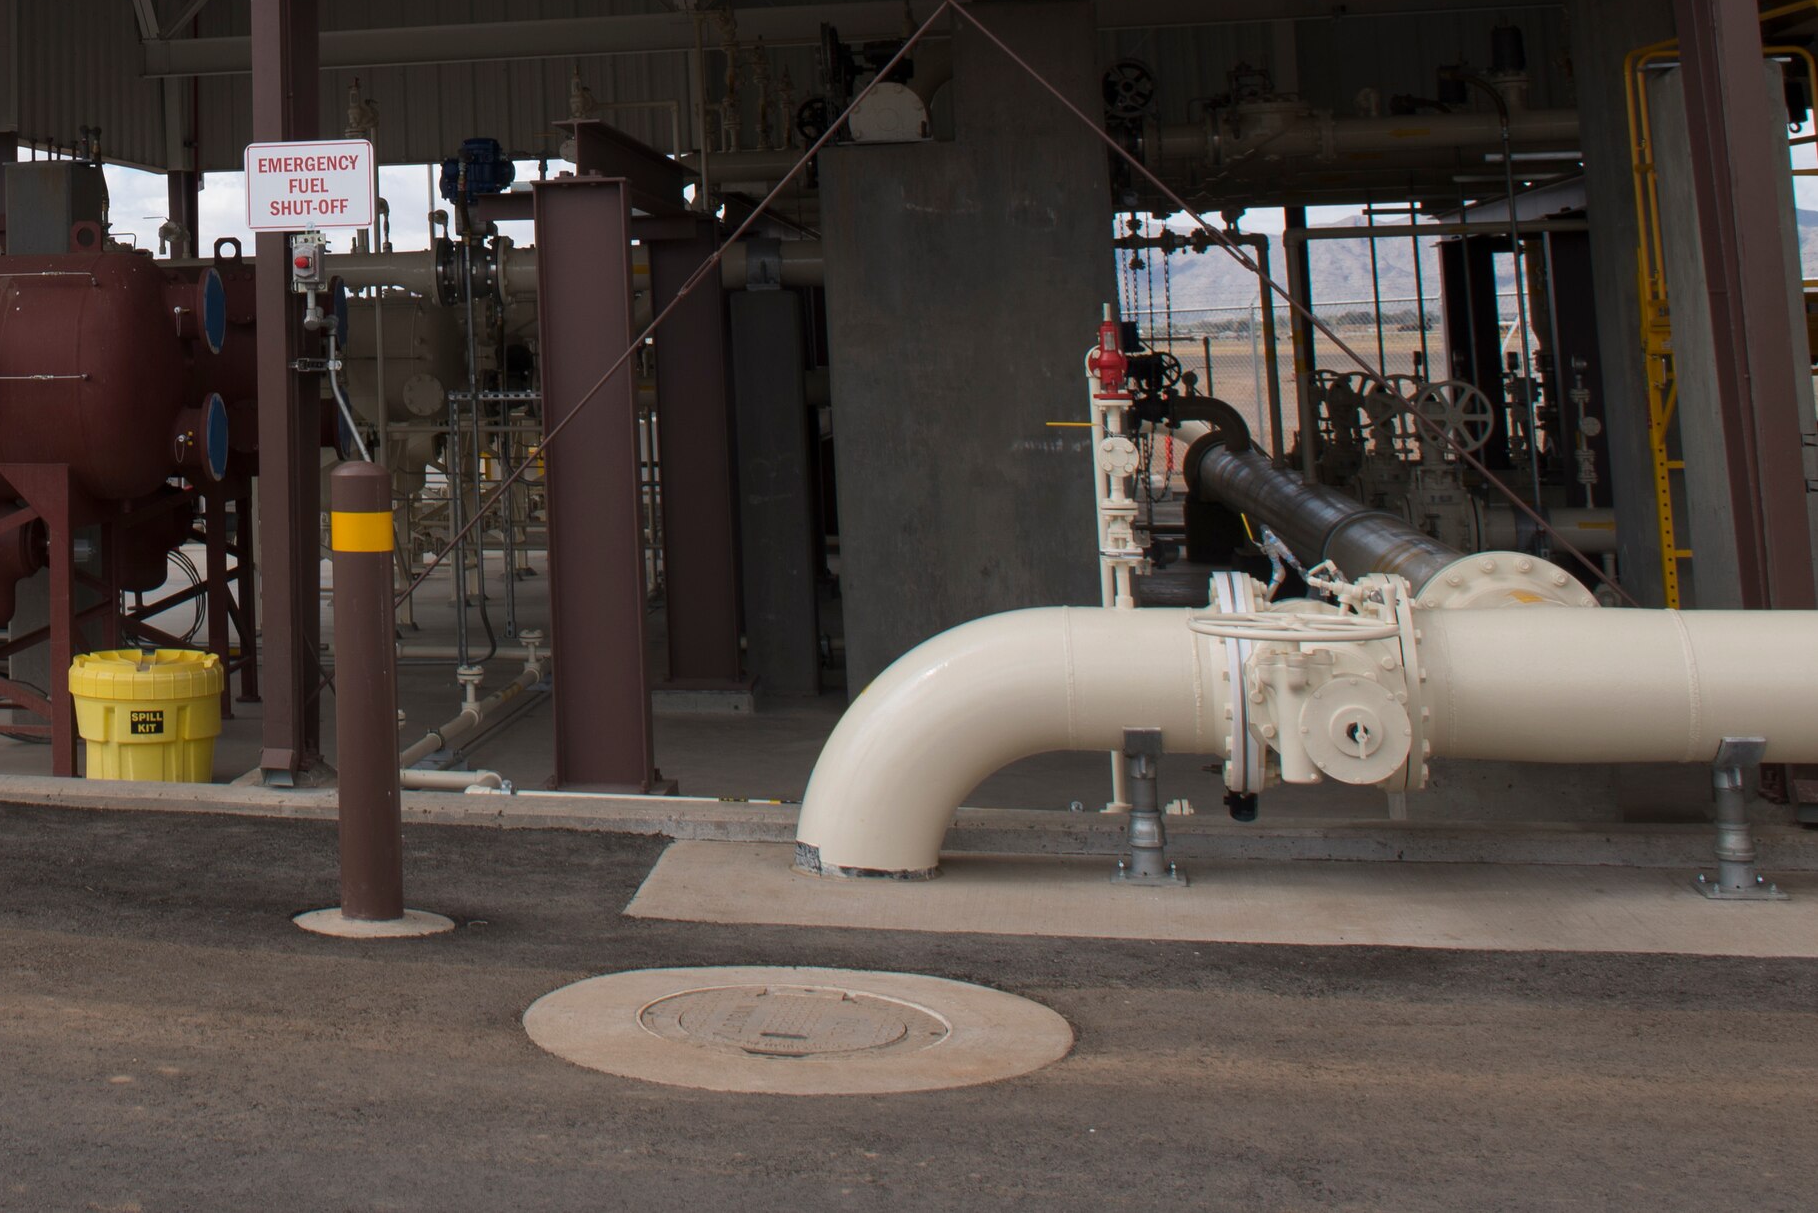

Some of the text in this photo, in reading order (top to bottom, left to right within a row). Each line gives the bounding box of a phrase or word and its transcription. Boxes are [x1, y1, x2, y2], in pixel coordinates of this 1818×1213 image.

[258, 154, 359, 174] EMERGENCY
[289, 178, 329, 194] FUEL
[270, 198, 349, 216] SHUT-OFF
[131, 712, 163, 722] SPILL
[137, 723, 157, 733] KIT
